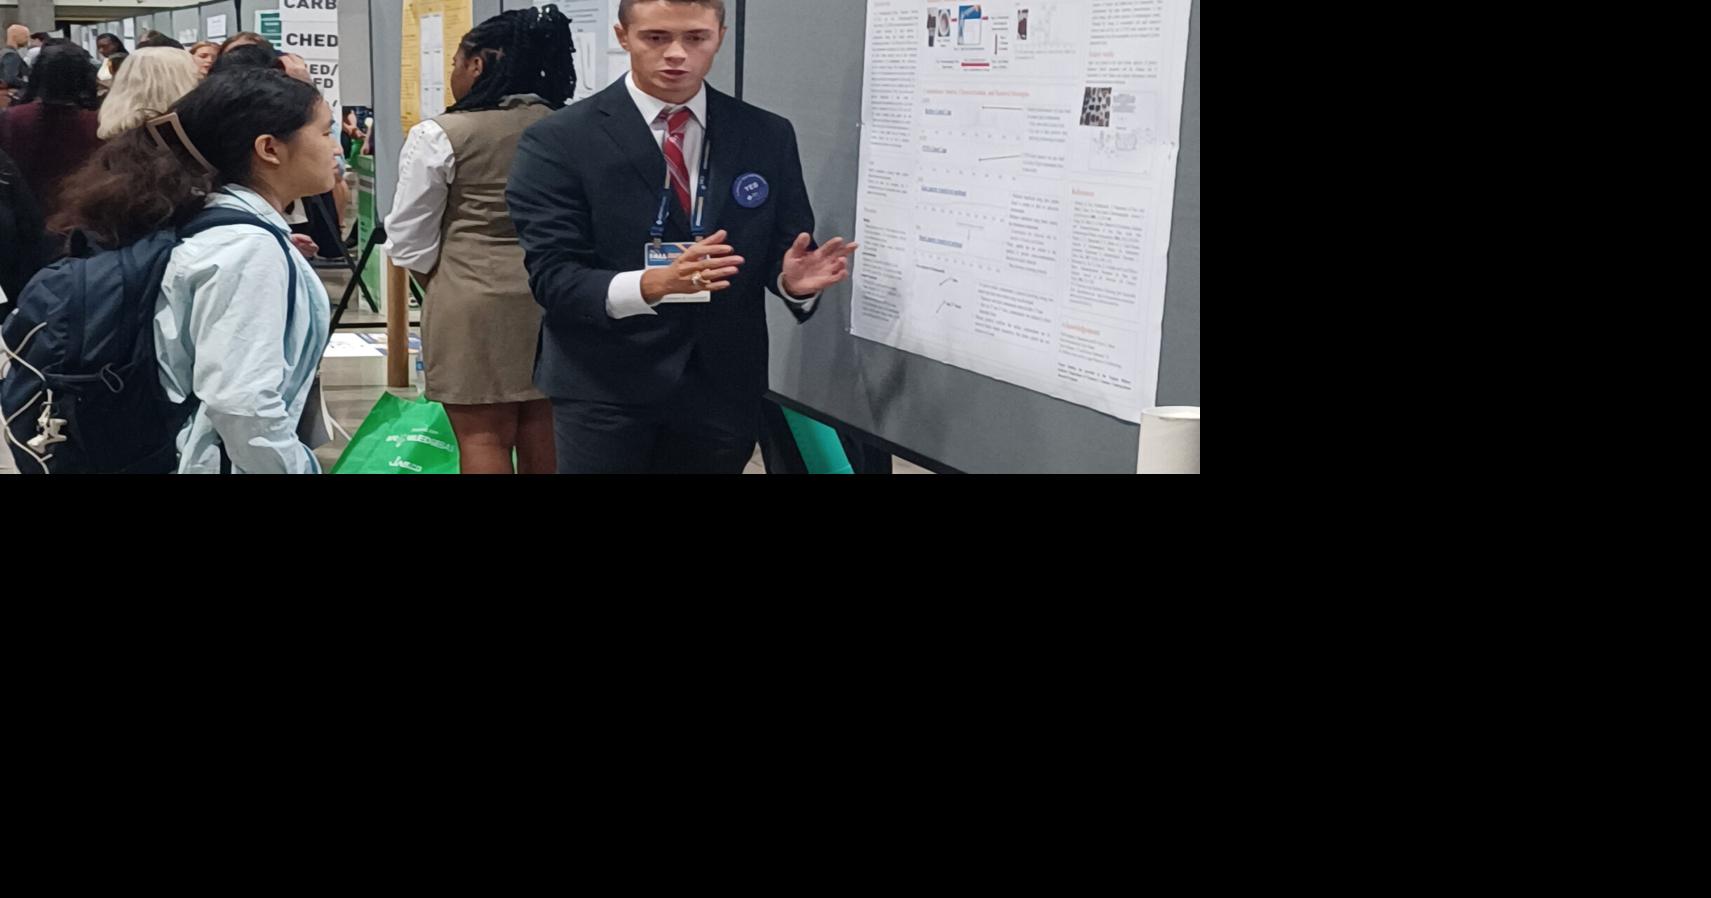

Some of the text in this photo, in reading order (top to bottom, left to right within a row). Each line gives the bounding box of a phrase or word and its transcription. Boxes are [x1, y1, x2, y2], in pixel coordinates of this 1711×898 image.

[284, 0, 337, 10] CARB
[286, 33, 339, 47] CHED
[304, 63, 338, 76] ED/
